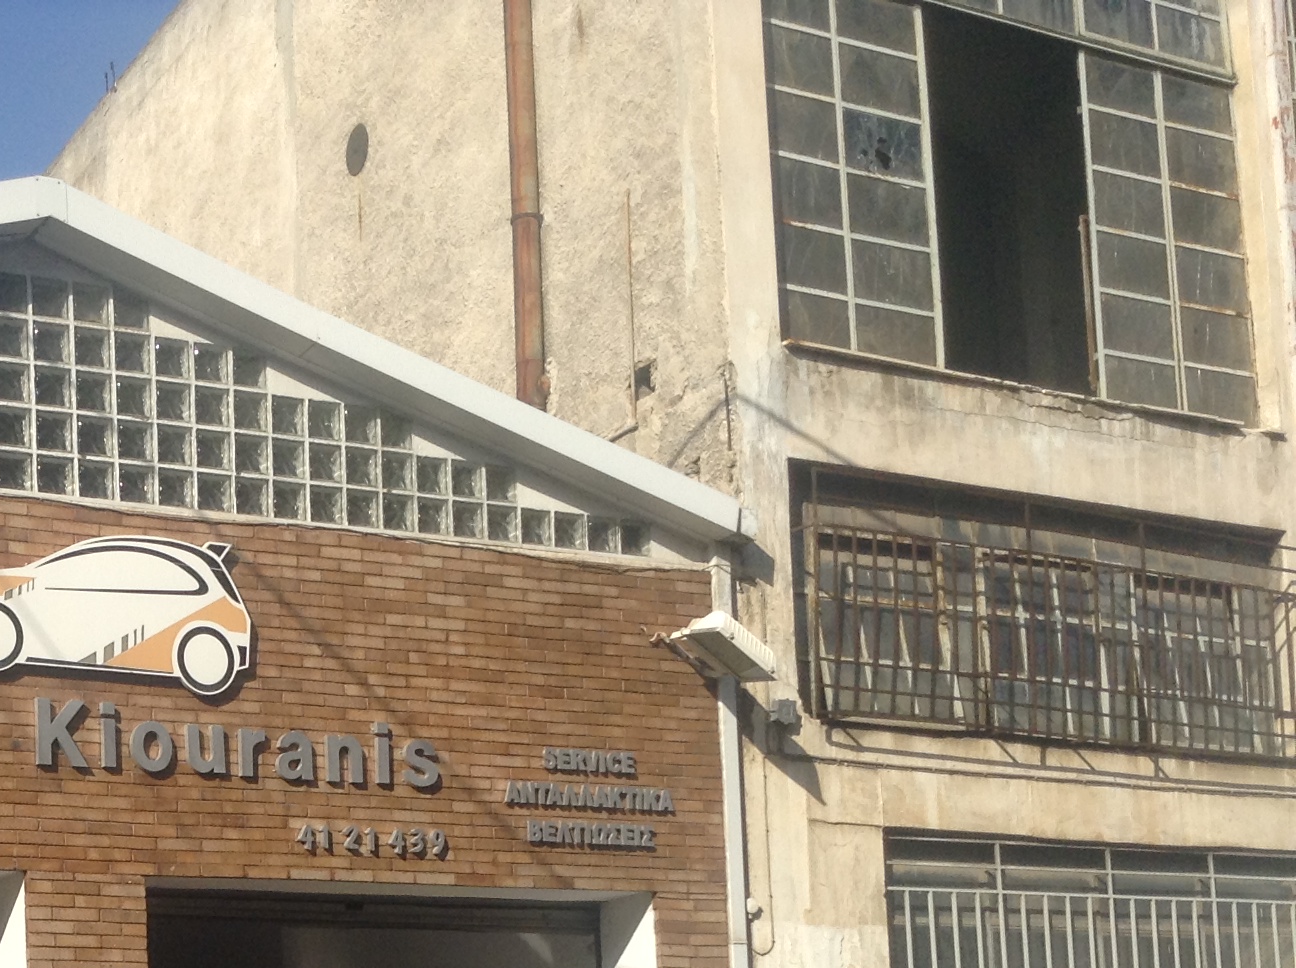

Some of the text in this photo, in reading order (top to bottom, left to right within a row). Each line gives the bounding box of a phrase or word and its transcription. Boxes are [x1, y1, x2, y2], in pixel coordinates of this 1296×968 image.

[33, 696, 443, 789] Kiouranis
[542, 746, 637, 774] SERVICE
[504, 780, 676, 812] ΑΝΤΑΛΛΑΚΤΙΚΑ
[526, 819, 656, 848] ΒΕΛΤΙΩΣΕΙΣ
